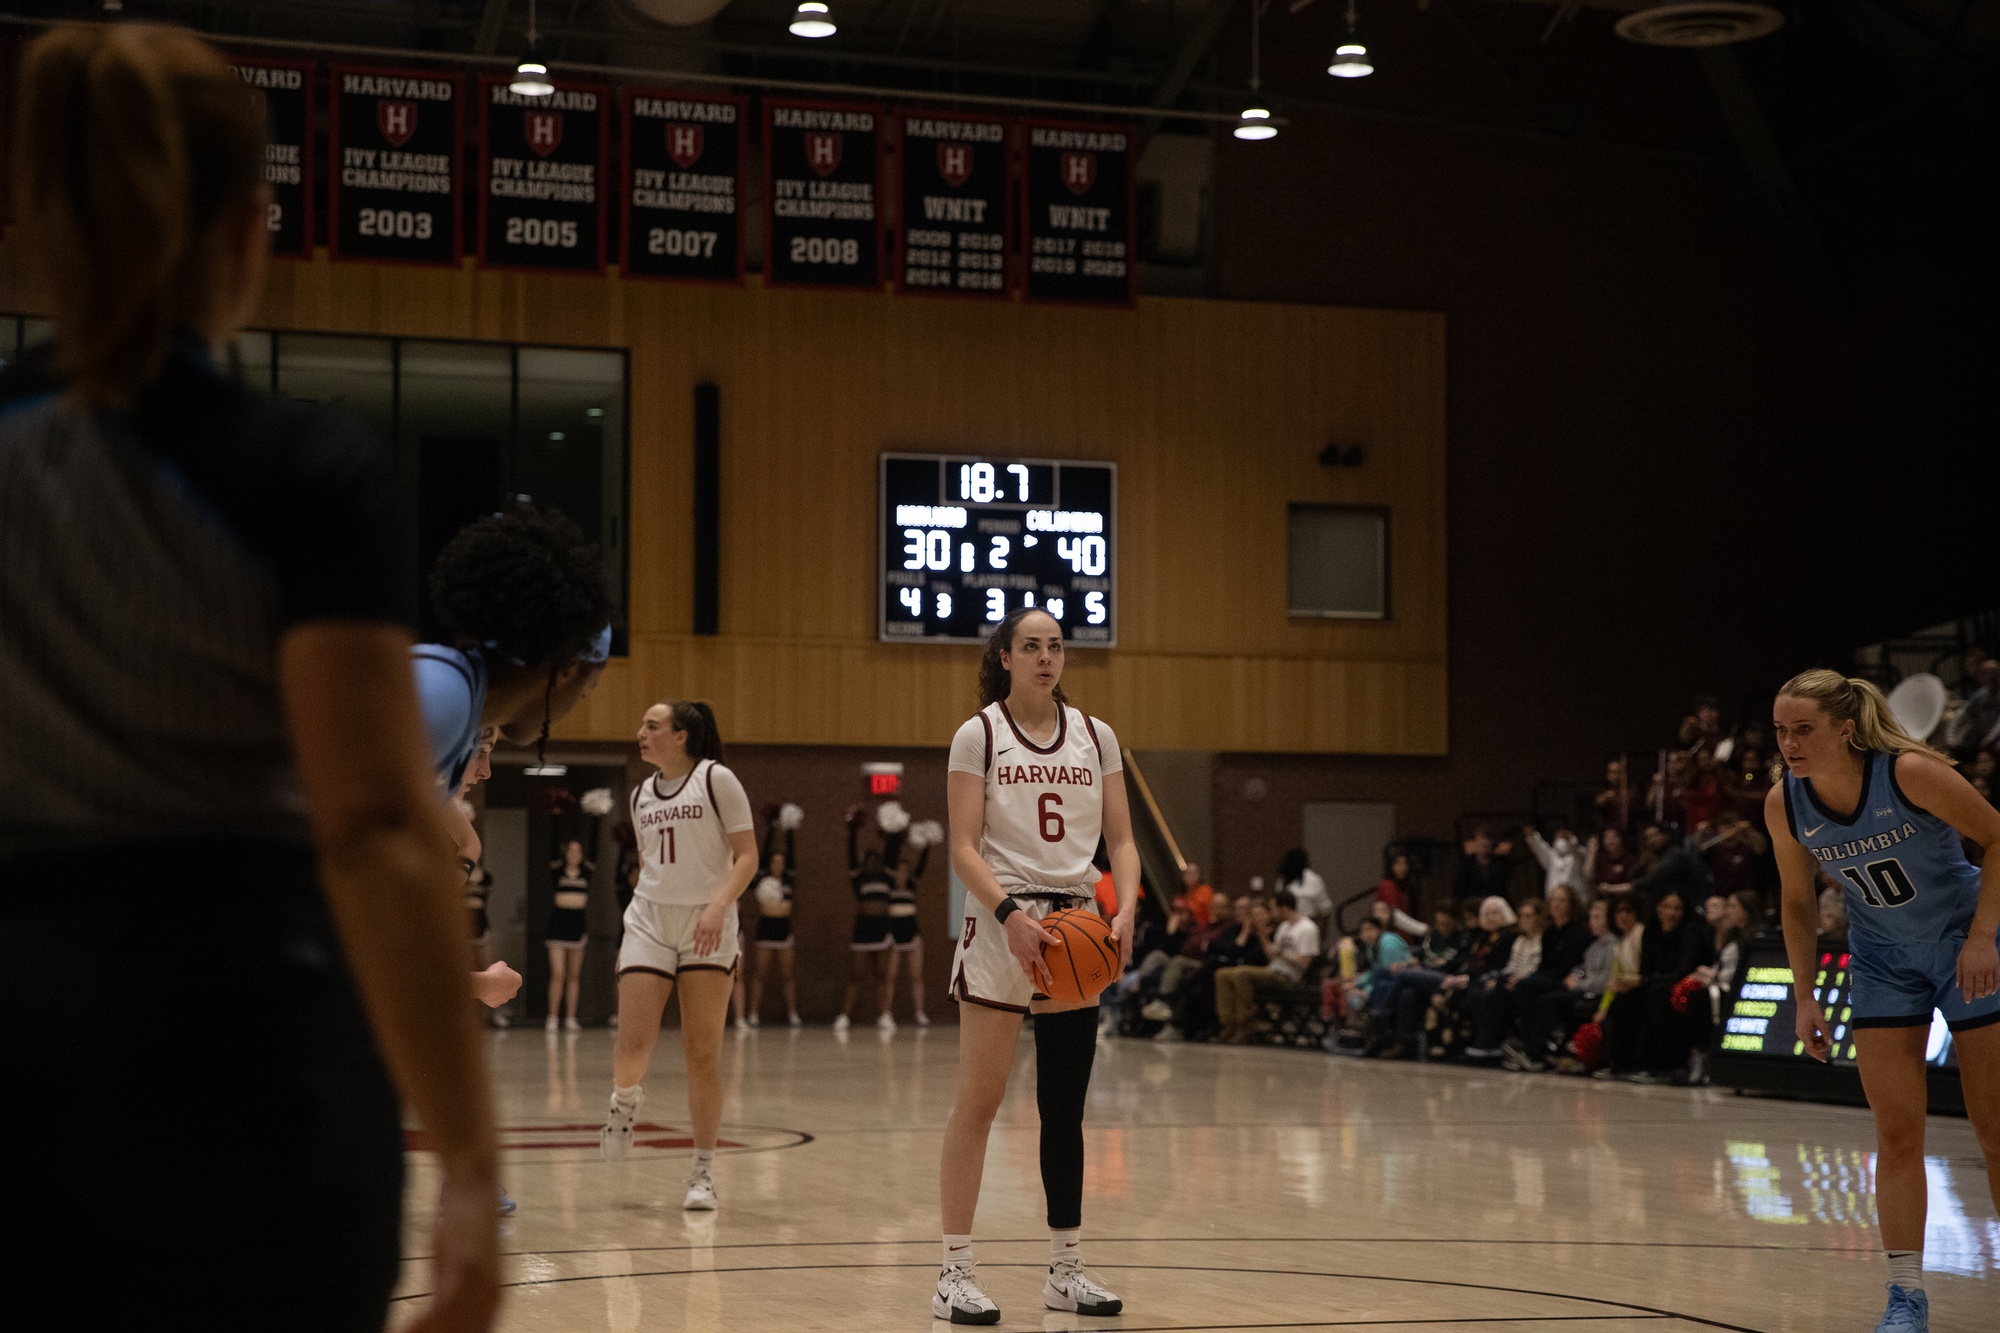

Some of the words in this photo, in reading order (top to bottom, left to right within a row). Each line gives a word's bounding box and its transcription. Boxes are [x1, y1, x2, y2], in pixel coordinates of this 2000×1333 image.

[343, 73, 452, 101] HARVARD
[386, 105, 408, 135] H
[633, 97, 736, 124] HARVARD
[773, 108, 874, 132] HARVARD
[533, 115, 554, 145] H
[674, 126, 695, 157] H
[905, 118, 1004, 143] HARVARD
[1031, 128, 1127, 152] HARVARD
[343, 147, 377, 168] IVY
[379, 150, 450, 174] LEAGUE
[814, 136, 834, 165] H
[945, 146, 965, 175] H
[342, 167, 451, 194] CHAMPIONS
[492, 157, 524, 178] IVY
[526, 159, 595, 183] LEAGUE
[634, 168, 666, 190] IVY
[667, 170, 735, 195] LEAGUE
[1069, 156, 1089, 183] H
[490, 177, 595, 203] CHAMPIONS
[632, 188, 735, 214] CHAMPIONS
[775, 179, 806, 199] IVY
[808, 180, 873, 202] LEAGUE
[358, 207, 433, 239] 2003
[774, 199, 875, 221] CHAMPIONS
[923, 195, 987, 223] WNIT
[1047, 204, 1111, 232] WNIT
[505, 216, 578, 249] 2005
[647, 227, 718, 259] 2007
[790, 236, 859, 265] 2008
[960, 462, 1029, 503] 18.7
[903, 529, 951, 571] 30
[989, 536, 1010, 569] 2
[1057, 535, 1106, 576] 40
[899, 587, 921, 617] 4
[936, 592, 952, 619] 3
[986, 588, 1005, 621] 3
[1085, 591, 1106, 624] 5
[998, 765, 1093, 787] HARVARD
[640, 805, 703, 829] HARVARD
[1038, 792, 1065, 842] 6
[659, 827, 675, 864] 11
[1811, 821, 1917, 861] COLUMBIA
[1840, 857, 1917, 908] 10
